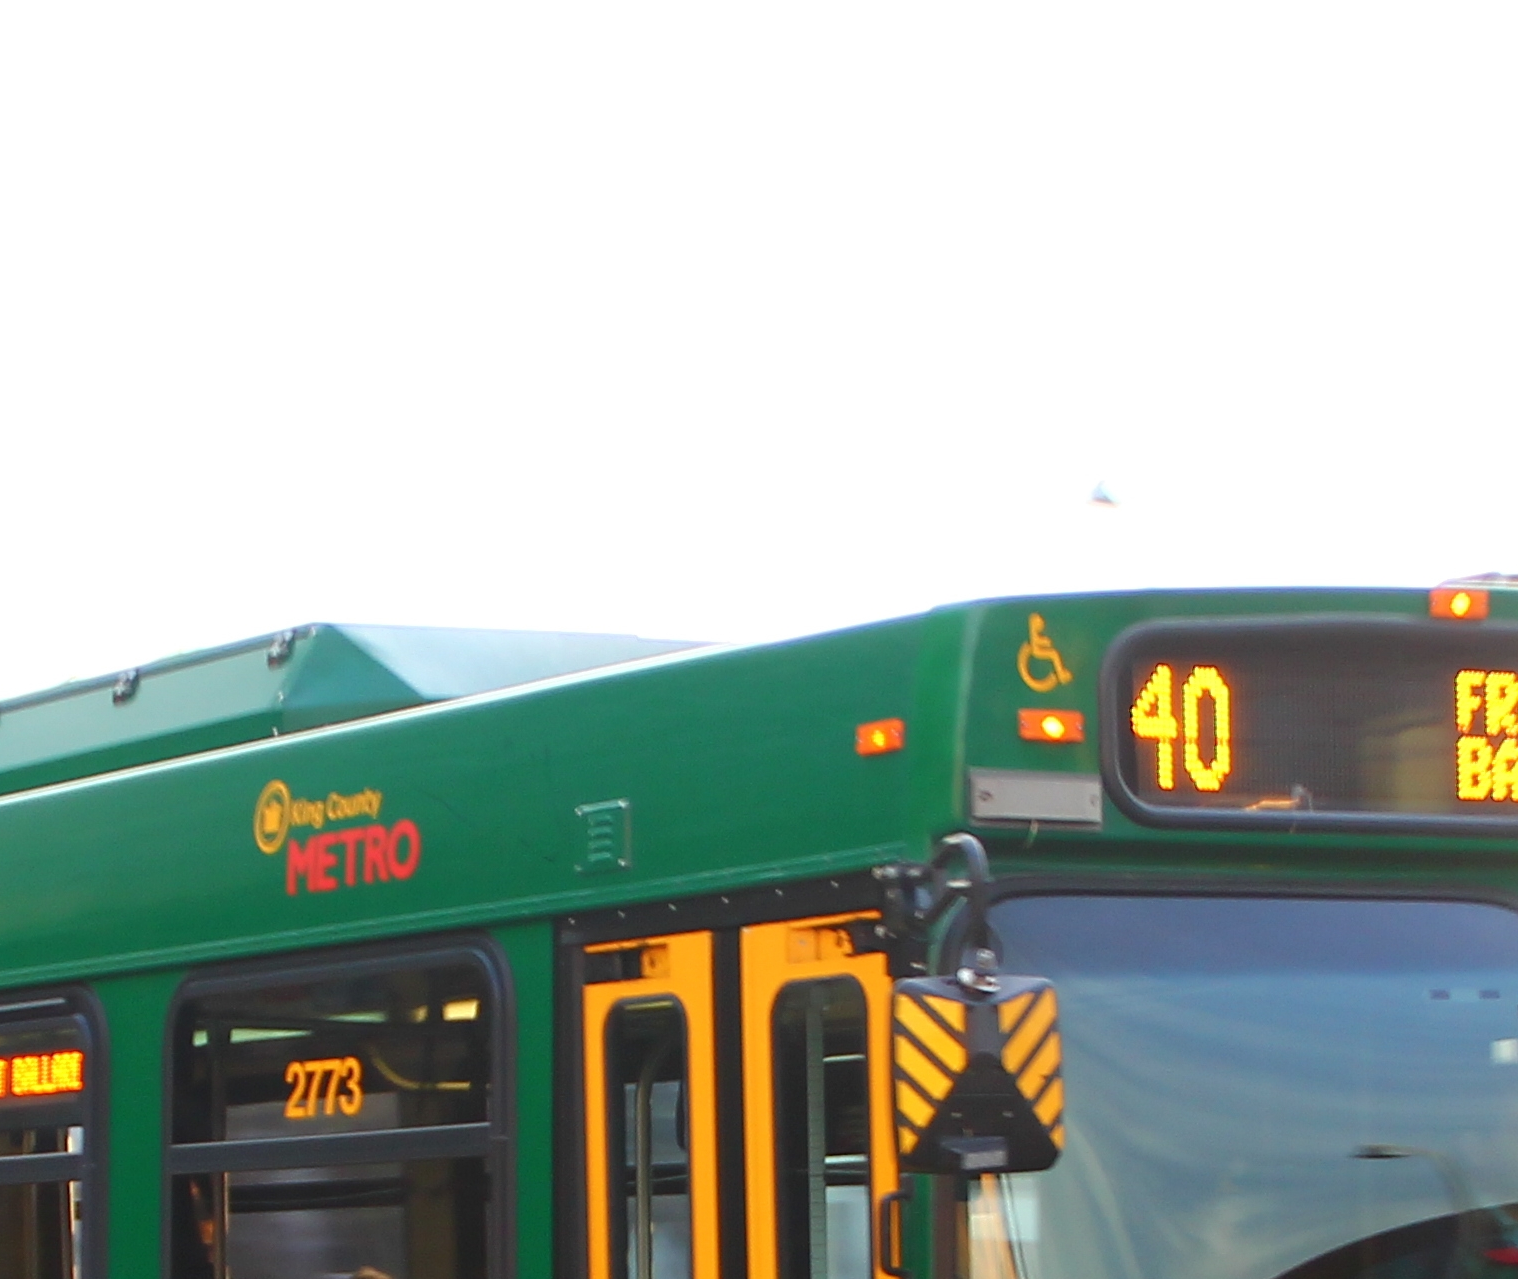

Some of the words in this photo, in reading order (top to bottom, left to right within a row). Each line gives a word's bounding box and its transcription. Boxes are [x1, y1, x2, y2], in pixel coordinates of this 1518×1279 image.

[1130, 664, 1230, 791] 40
[289, 798, 325, 829] King
[326, 787, 382, 821] County
[286, 818, 421, 896] METRO
[284, 1056, 363, 1119] 2773
